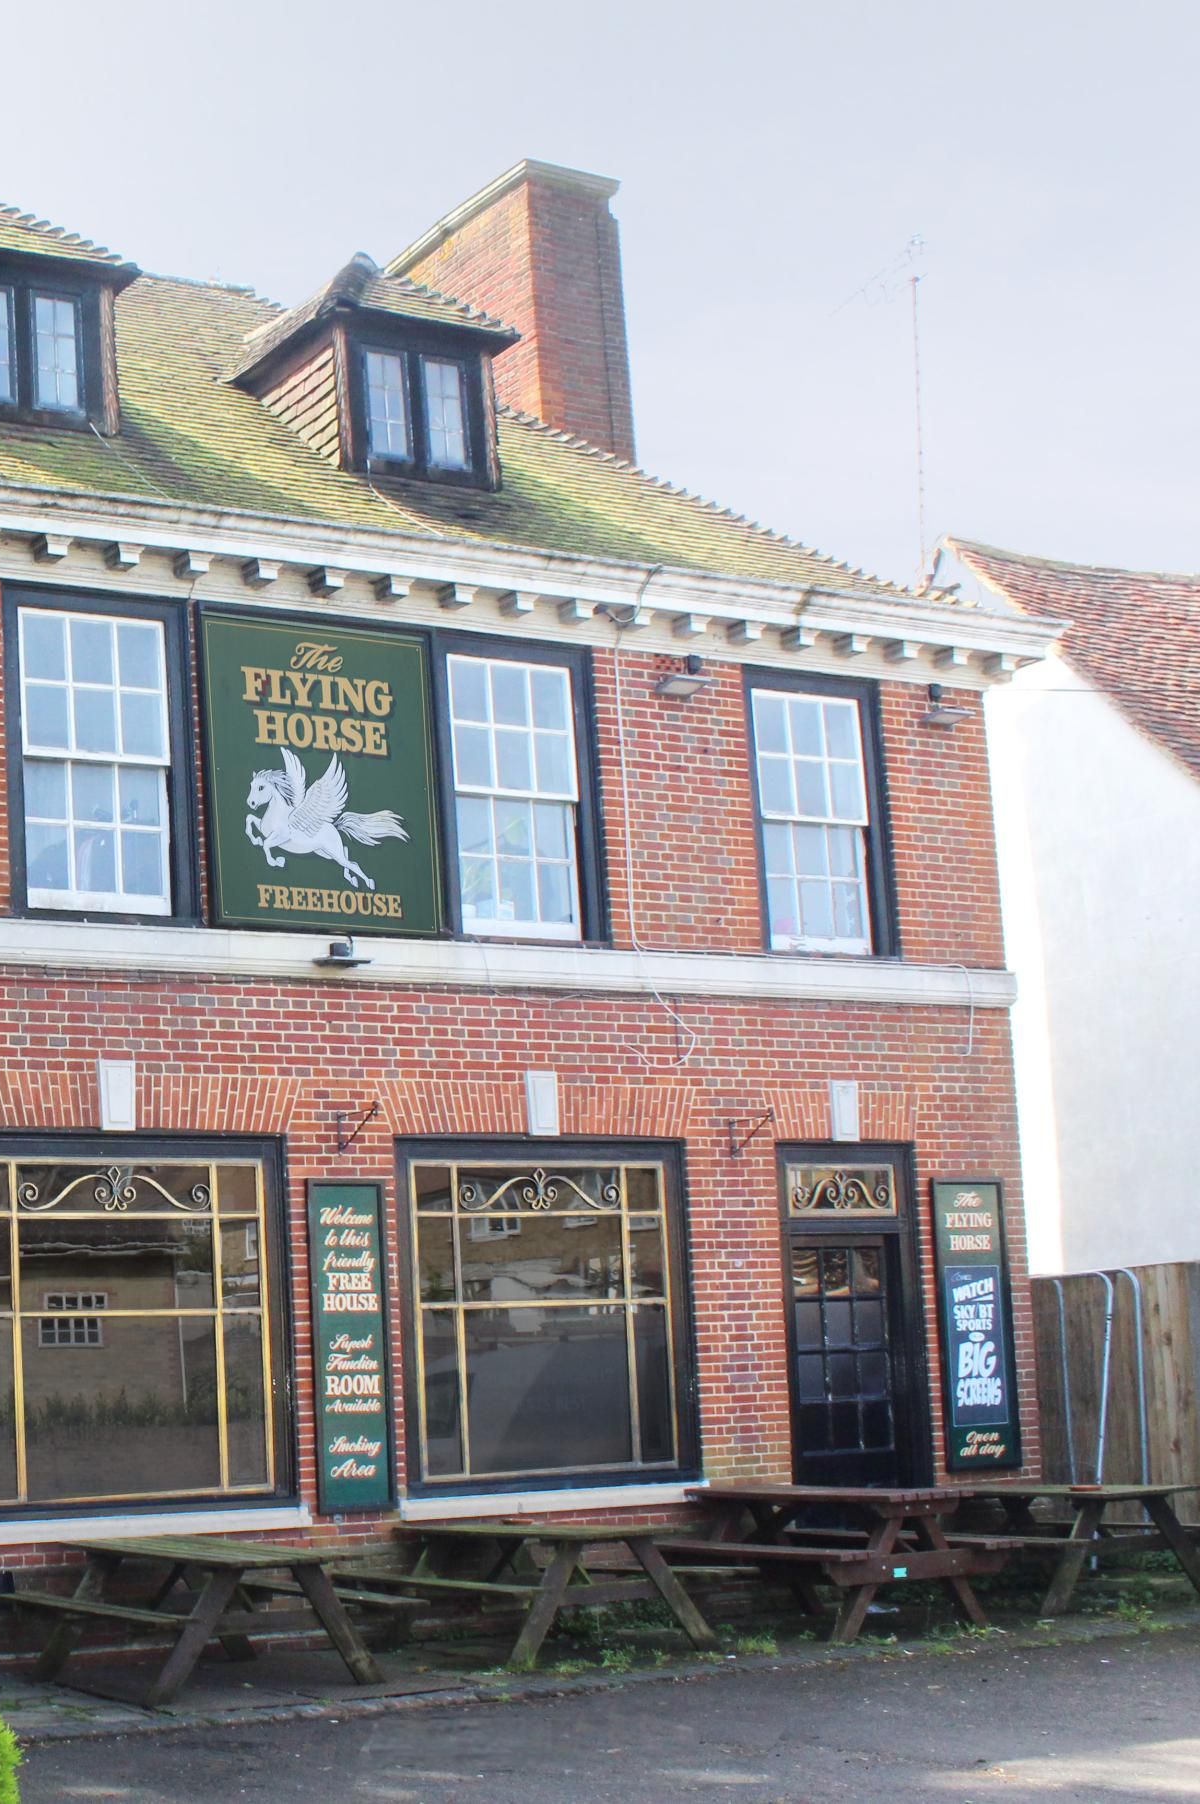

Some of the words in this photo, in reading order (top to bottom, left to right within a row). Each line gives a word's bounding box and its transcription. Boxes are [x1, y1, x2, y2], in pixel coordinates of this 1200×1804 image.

[290, 641, 344, 673] The
[240, 665, 393, 717] FLYING
[253, 708, 388, 756] HORSE
[256, 884, 402, 918] FREEHOUSE
[953, 1191, 983, 1208] The
[319, 1204, 374, 1226] Welcome
[944, 1212, 993, 1229] FLYING
[324, 1228, 338, 1247] to
[339, 1228, 370, 1248] this
[949, 1234, 992, 1252] HORSE
[322, 1250, 376, 1273] friendly
[326, 1272, 373, 1292] FREE
[952, 1277, 994, 1303] WATCH
[322, 1293, 379, 1313] HOUSE
[956, 1318, 993, 1332] SPORTS
[330, 1333, 372, 1352] Superb
[326, 1353, 378, 1372] Function
[958, 1341, 997, 1378] BIG
[325, 1374, 381, 1395] ROOM
[956, 1377, 1002, 1407] SCREENS
[325, 1398, 381, 1415] Available
[329, 1435, 381, 1457] Smoking
[966, 1431, 1000, 1444] Open
[960, 1443, 977, 1458] all
[979, 1442, 1005, 1459] day
[330, 1458, 377, 1478] Area
